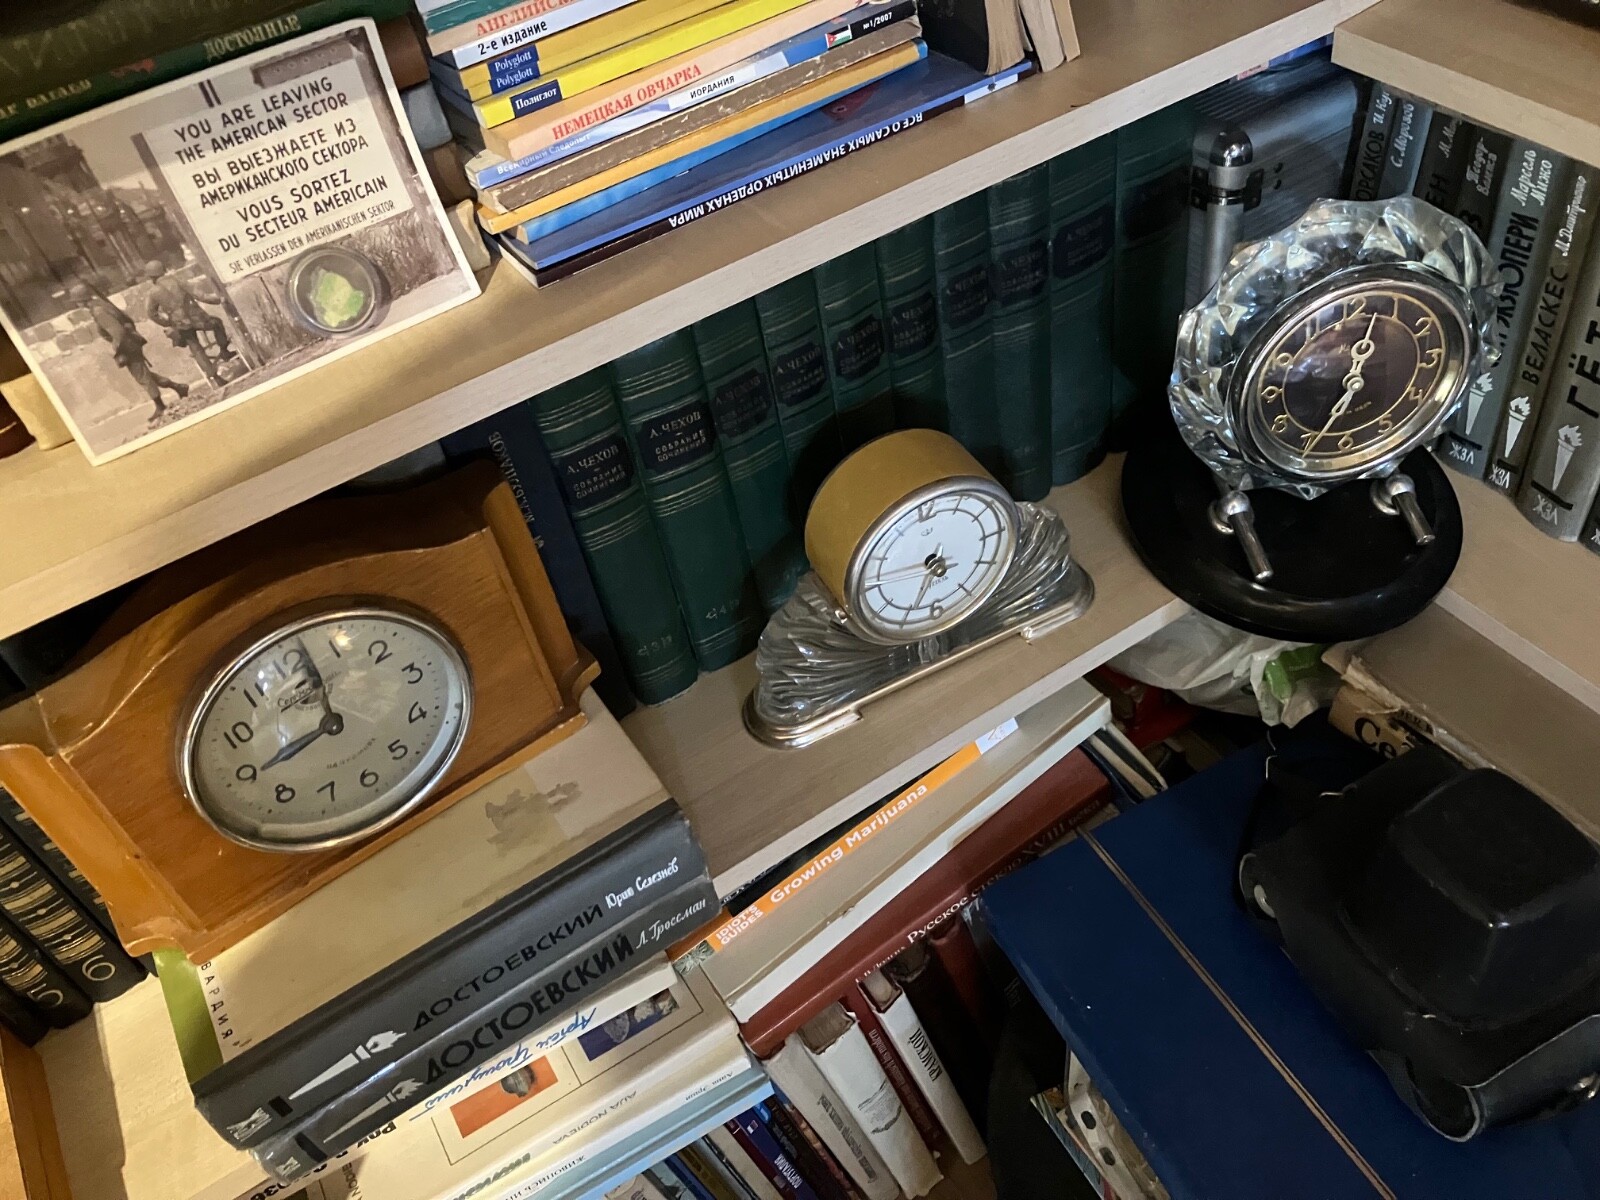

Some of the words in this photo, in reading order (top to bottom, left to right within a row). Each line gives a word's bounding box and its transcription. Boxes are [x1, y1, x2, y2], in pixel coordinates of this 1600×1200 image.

[478, 38, 499, 56] 2-е
[501, 20, 548, 47] издание
[494, 50, 532, 73] Polyglott
[496, 67, 534, 89] Polyglott
[690, 75, 735, 99] ИОРДАНИЯ
[174, 119, 212, 143] YOU
[221, 104, 256, 128] ARE
[262, 76, 333, 113] LEAVING
[515, 86, 557, 111] Полиглот
[552, 96, 634, 141] НЕМЕЦКАЯ
[637, 64, 702, 102] ОВЧАРКА
[175, 143, 206, 165] THE
[211, 114, 287, 153] AMERICAN
[293, 92, 349, 123] SECTOR
[848, 128, 891, 152] САМЫХ
[192, 167, 222, 189] ВЫ
[227, 128, 328, 175] ВЫЕЗЖАЕТЕ
[334, 118, 358, 137] ИЗ
[1356, 130, 1385, 200] ОРСАКОВ
[1376, 91, 1394, 113] Ку
[200, 158, 309, 208] АМЕРИКАНСКОГО
[312, 135, 369, 166] СЕКТОРА
[765, 145, 847, 188] ЗНАМЕНИТЫХ
[1510, 150, 1537, 206] Марсель
[236, 195, 284, 223] VOUS
[290, 168, 352, 203] SORTEZ
[707, 180, 763, 211] ОРДЕНАХ
[218, 233, 240, 253] DU
[245, 207, 308, 242] SECTEUR
[668, 206, 706, 228] МИРА
[229, 258, 247, 274] SIE
[244, 242, 288, 268] VERLASSEN
[289, 235, 304, 250] DEN
[305, 211, 367, 244] AMERIKANISCHEN
[367, 199, 396, 219] SEKTOR
[1341, 296, 1366, 322] 12
[1391, 297, 1398, 320] 1
[1306, 316, 1321, 344] 11
[1415, 316, 1434, 338] 2
[1522, 267, 1569, 386] ВЕЛАСКЕС
[1420, 348, 1440, 368] 3
[1567, 292, 1600, 419] ГЁТ
[1261, 386, 1282, 404] 9
[1409, 387, 1423, 405] 4
[662, 411, 701, 433] ЧЕХОВ
[1271, 414, 1288, 433] 8
[1378, 413, 1394, 433] 5
[1337, 431, 1353, 449] 6
[580, 444, 619, 469] ЧЕХОВ
[917, 500, 937, 523] 12
[930, 600, 943, 620] 6
[329, 639, 341, 658] 1
[367, 639, 392, 664] 2
[402, 662, 424, 684] 3
[243, 682, 265, 708] 11
[407, 702, 427, 724] 4
[224, 721, 254, 749] 10
[387, 739, 408, 760] 5
[235, 764, 258, 782] 9
[360, 768, 379, 788] 6
[275, 784, 295, 803] 8
[317, 781, 337, 801] 7
[770, 844, 844, 903] Growing
[844, 783, 928, 849] Marijuana
[715, 903, 759, 939] IDIOT'S
[720, 911, 764, 946] GUIDES
[906, 896, 968, 945] Русское
[81, 954, 116, 981] 6
[413, 904, 604, 1031] ДОСТОЕВСКИЙ
[606, 887, 635, 909] Юрий
[200, 961, 234, 1040] ВАРДИЯ
[425, 931, 635, 1085] ДОСТОЕВСКИЙ
[649, 899, 707, 943] Гроссман
[342, 1162, 361, 1196] NODIE
